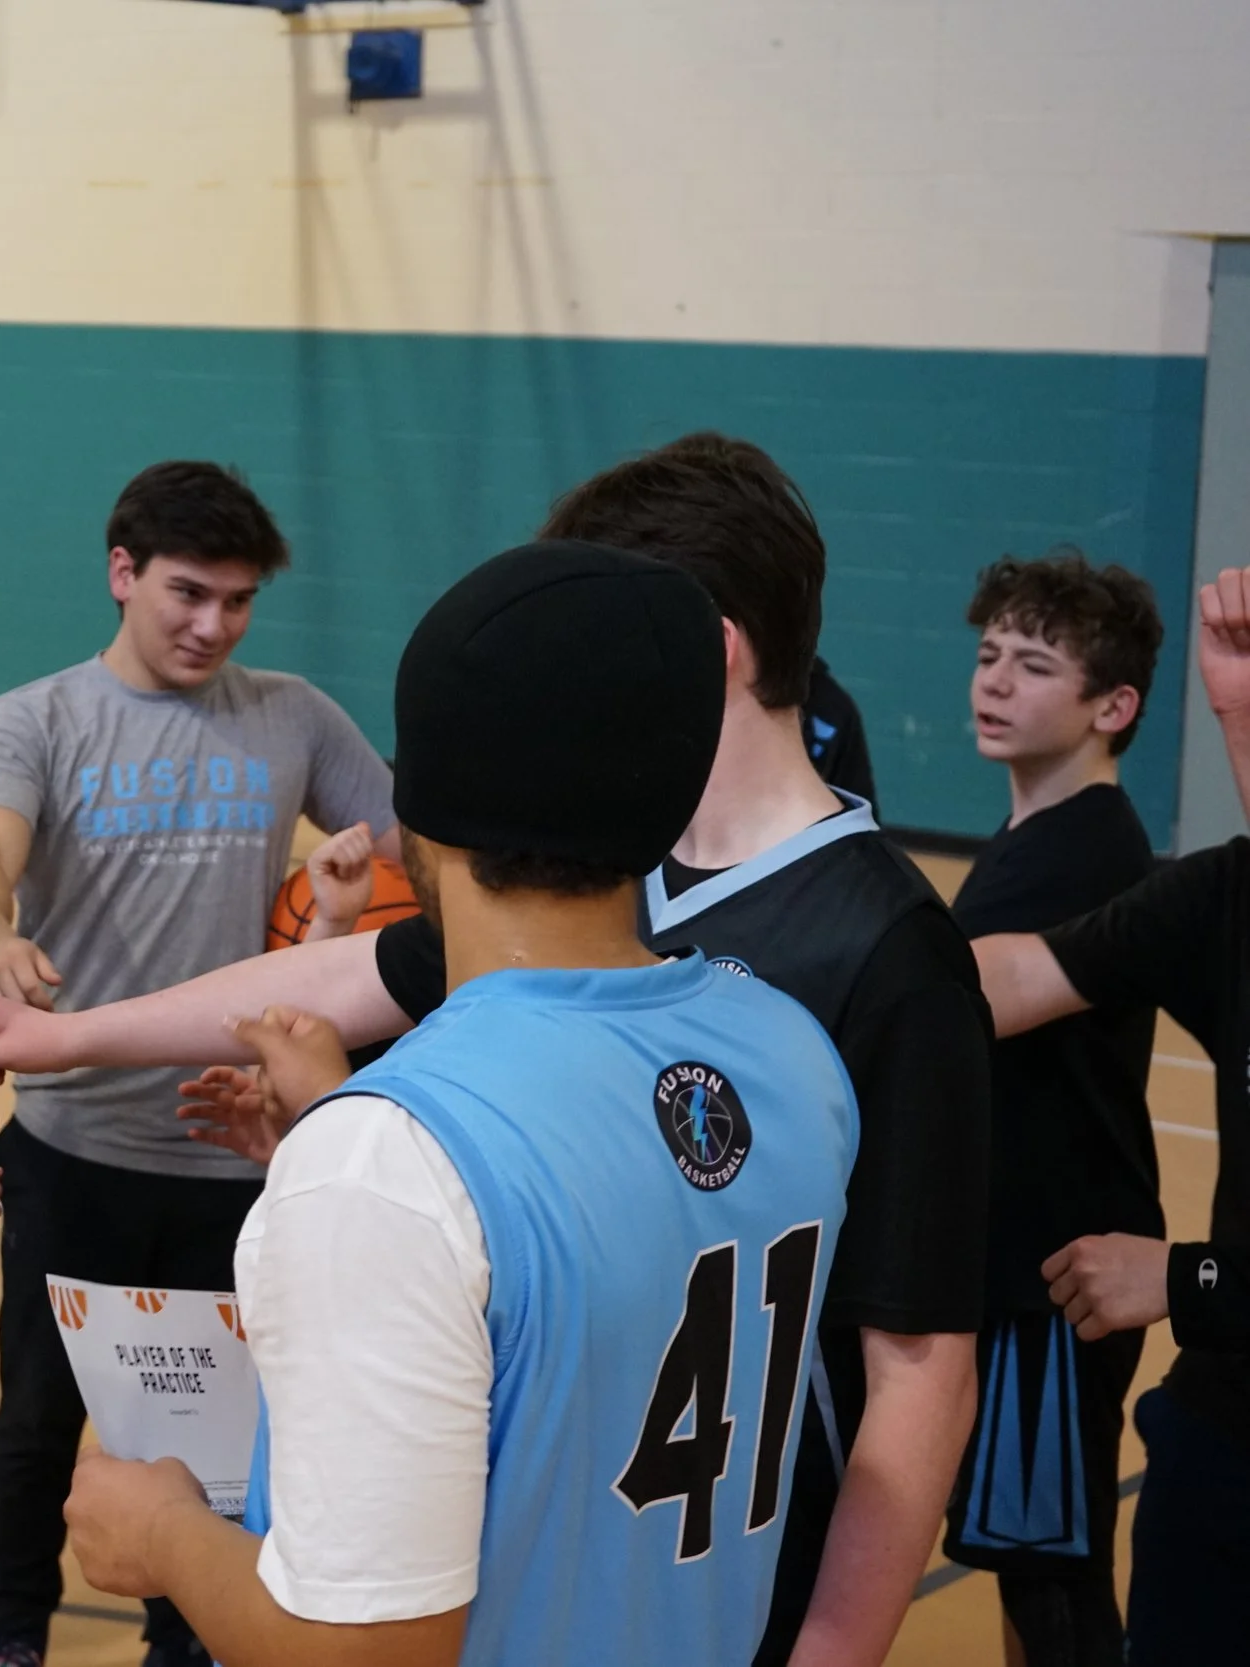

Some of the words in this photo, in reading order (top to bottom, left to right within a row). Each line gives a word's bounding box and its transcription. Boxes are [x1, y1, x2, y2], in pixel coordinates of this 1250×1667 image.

[80, 756, 269, 806] FUSION
[657, 1066, 723, 1104] FUSION
[677, 1147, 747, 1187] BASKETBALL
[115, 1344, 169, 1368] PLAYER
[169, 1346, 186, 1368] OF
[189, 1347, 217, 1369] THE
[139, 1371, 206, 1394] PRACTICE
[609, 1218, 823, 1565] 41
